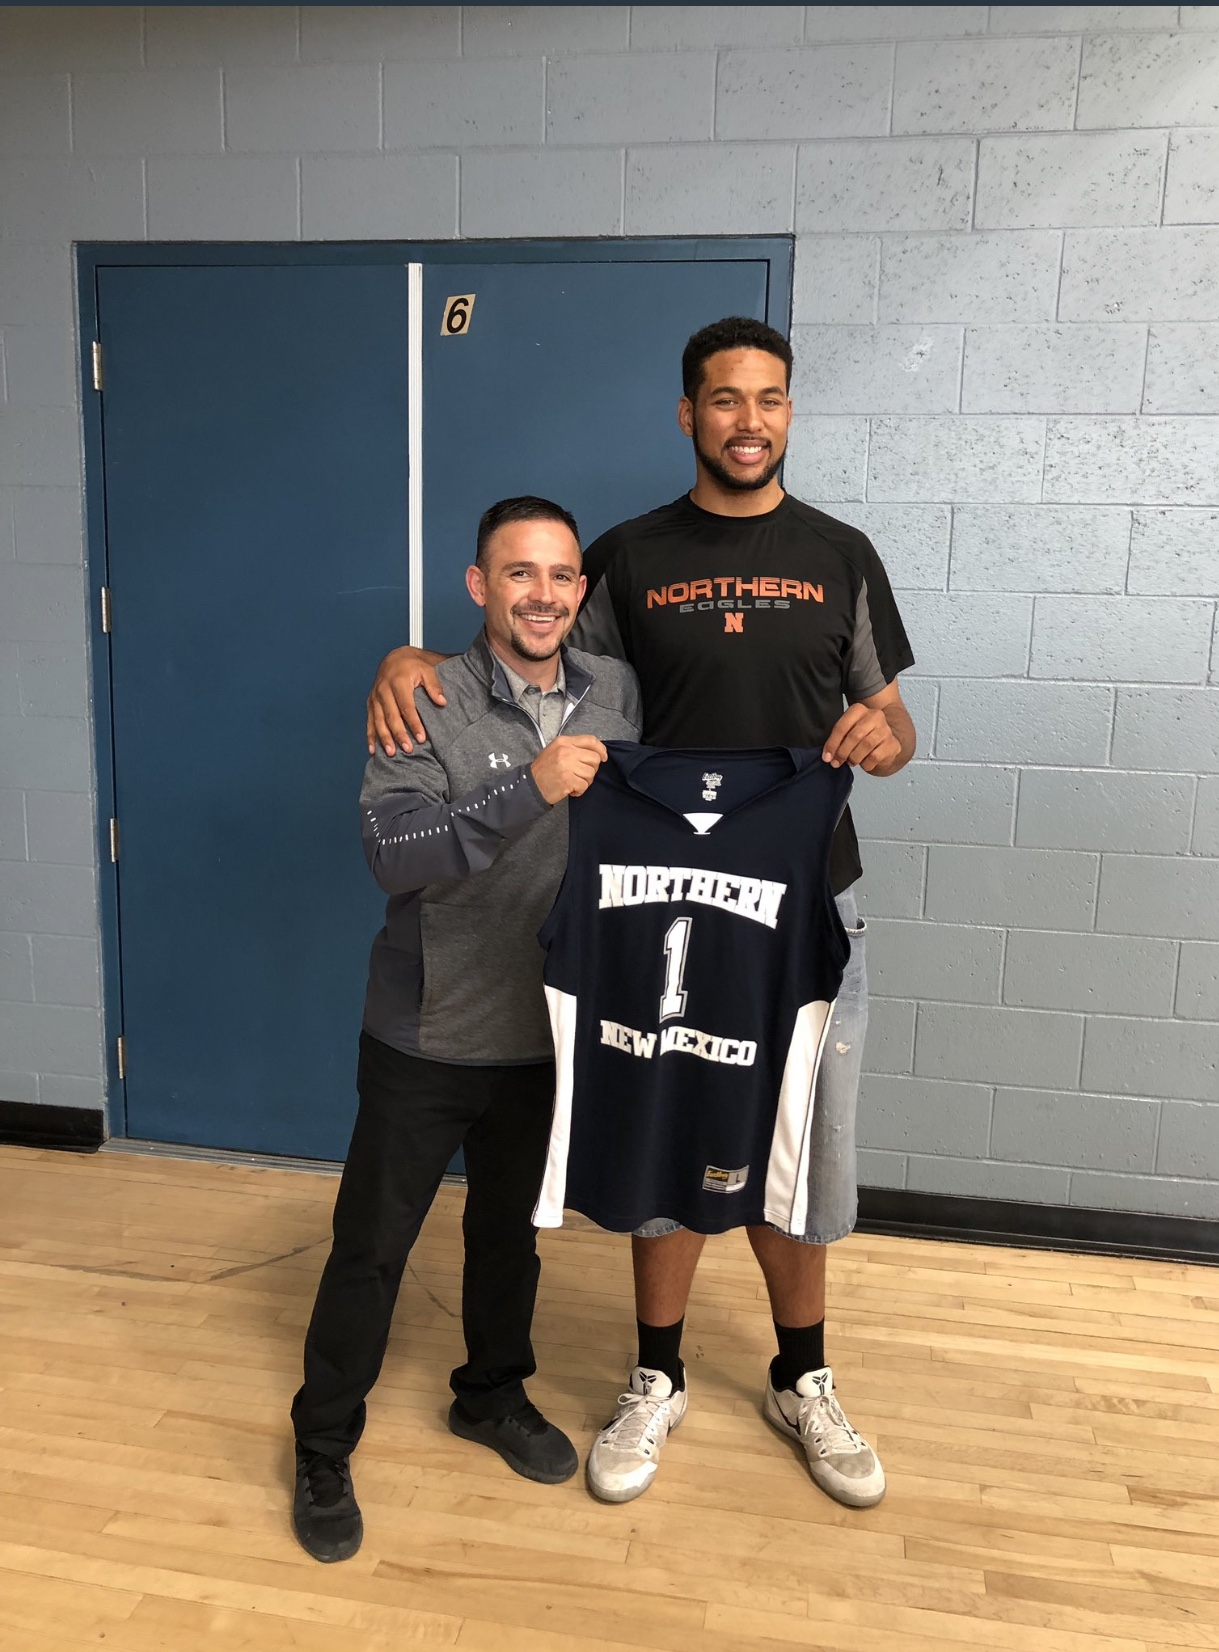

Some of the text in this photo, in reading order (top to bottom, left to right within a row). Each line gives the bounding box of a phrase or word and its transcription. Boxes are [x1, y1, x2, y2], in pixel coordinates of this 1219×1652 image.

[446, 297, 469, 334] 6
[646, 576, 824, 609] NORTHERN
[724, 612, 744, 633] N
[599, 863, 787, 930] NORTHERN
[659, 916, 693, 1023] 1
[600, 1019, 658, 1059] NEW
